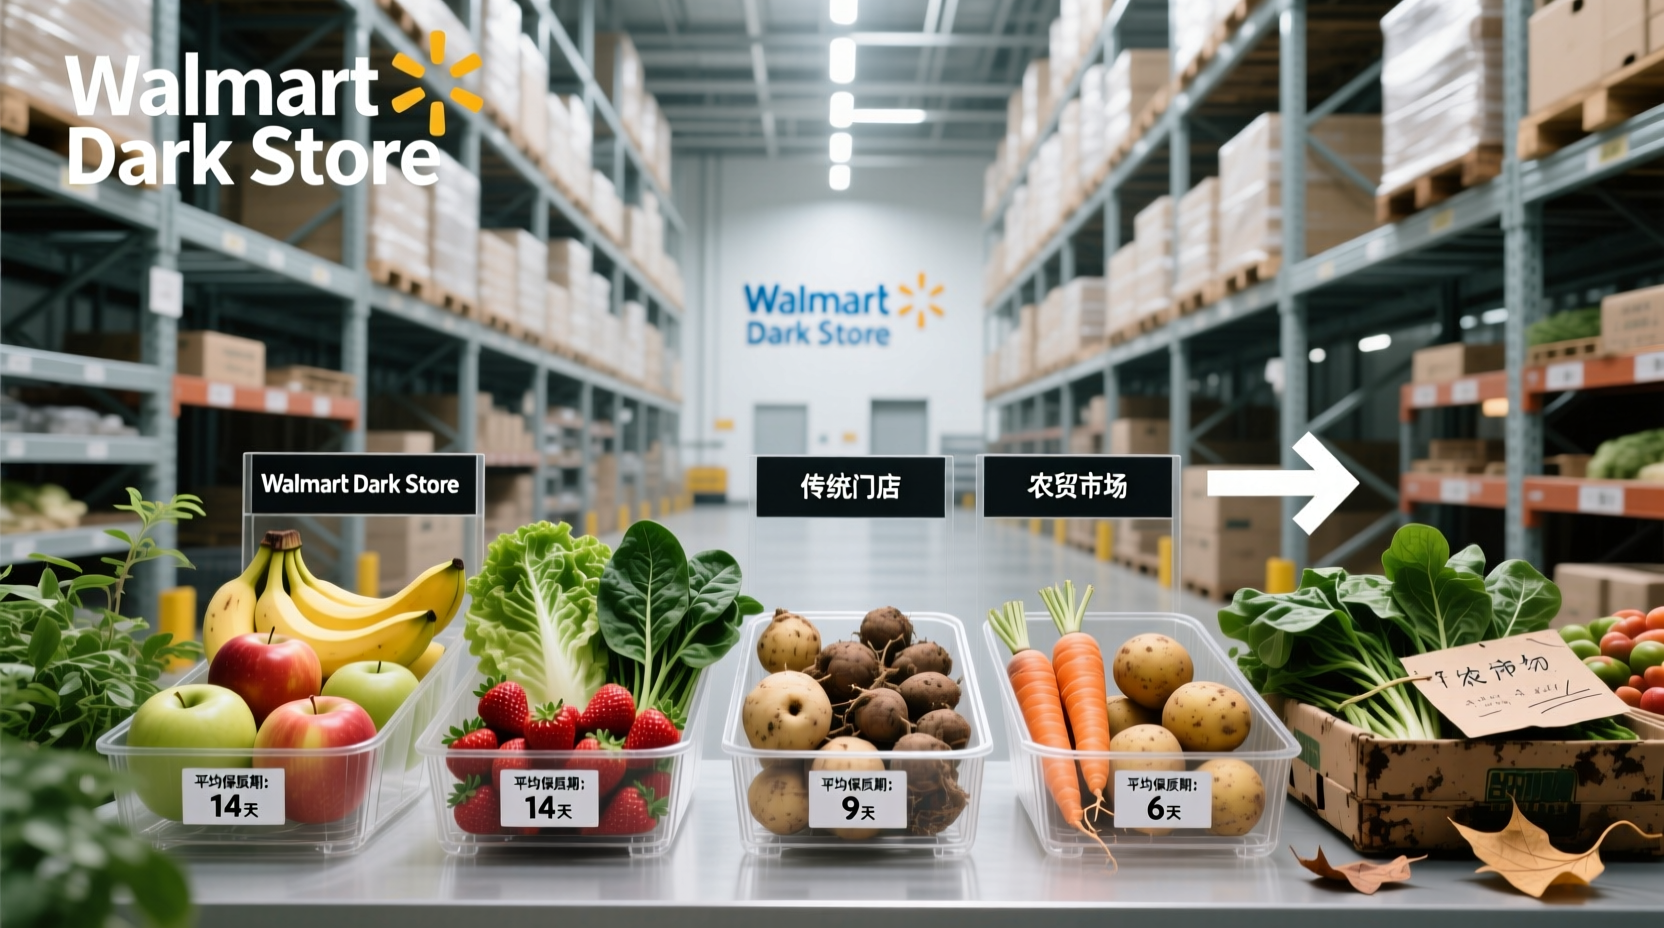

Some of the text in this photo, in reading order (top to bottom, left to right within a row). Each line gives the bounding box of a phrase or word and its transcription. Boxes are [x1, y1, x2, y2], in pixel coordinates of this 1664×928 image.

[744, 284, 889, 316] Walmart
[746, 320, 890, 346] Dark Store
[260, 473, 460, 495] Walmart Dark Store
[800, 472, 901, 501] 传统门店
[1027, 472, 1128, 501] 农贸市场
[210, 793, 259, 818] 14天
[524, 795, 573, 820] 14天
[841, 795, 876, 821] 9天
[1147, 795, 1182, 821] 6天
